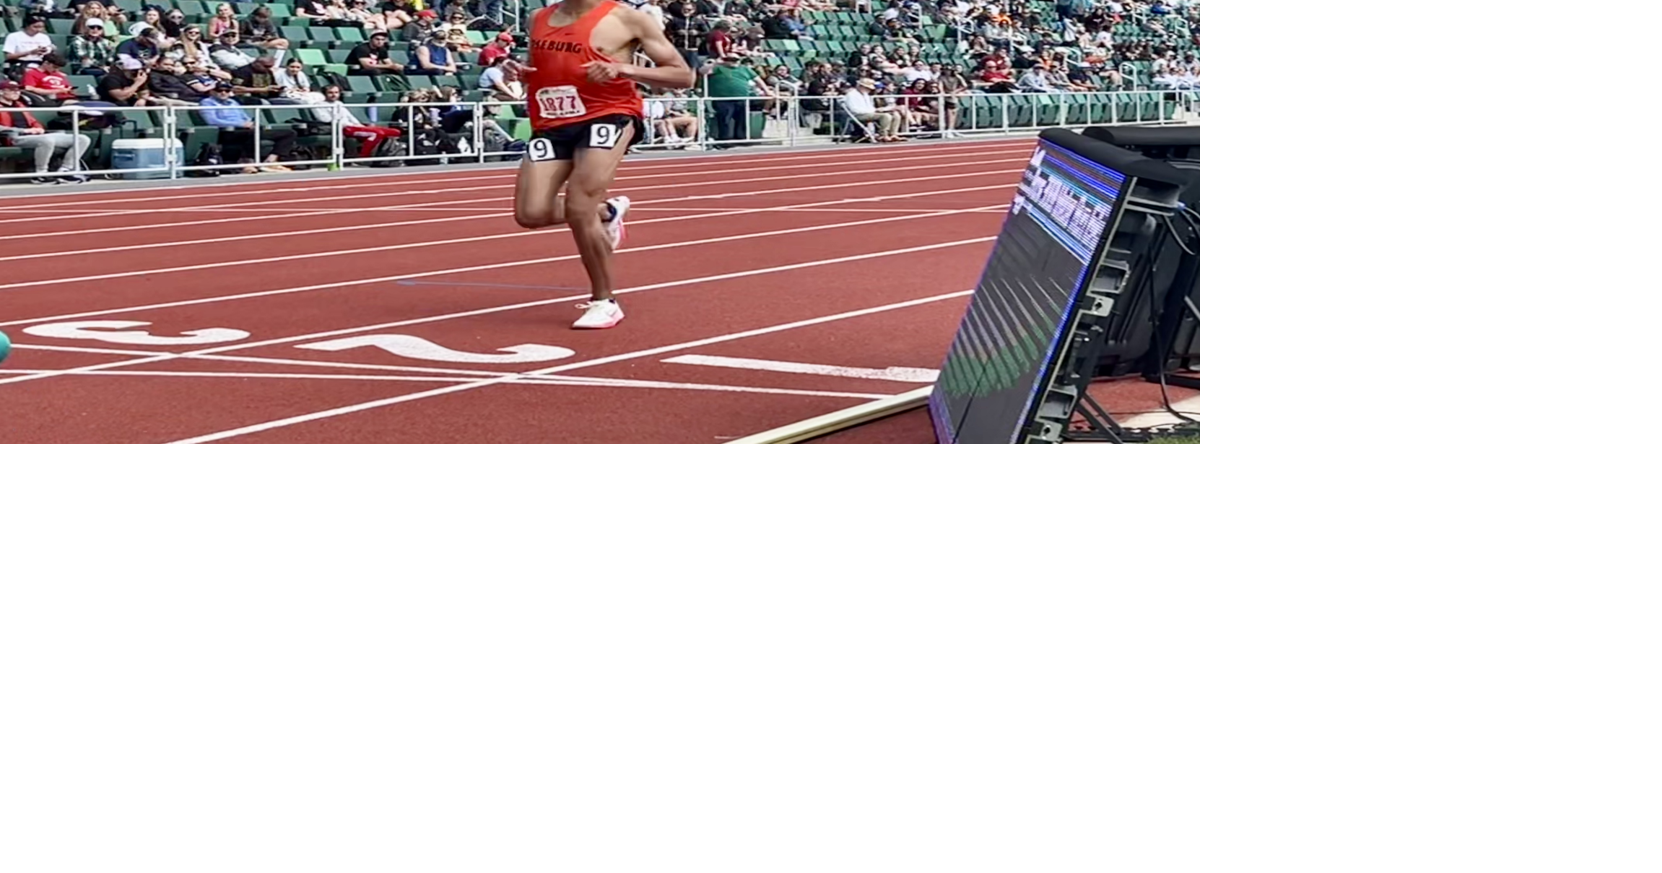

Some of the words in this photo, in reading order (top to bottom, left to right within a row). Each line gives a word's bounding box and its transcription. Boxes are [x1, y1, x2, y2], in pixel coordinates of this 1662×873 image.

[540, 95, 576, 111] 1877
[596, 126, 610, 145] 9
[534, 140, 548, 158] 9
[22, 320, 250, 345] 3
[294, 333, 576, 364] 2
